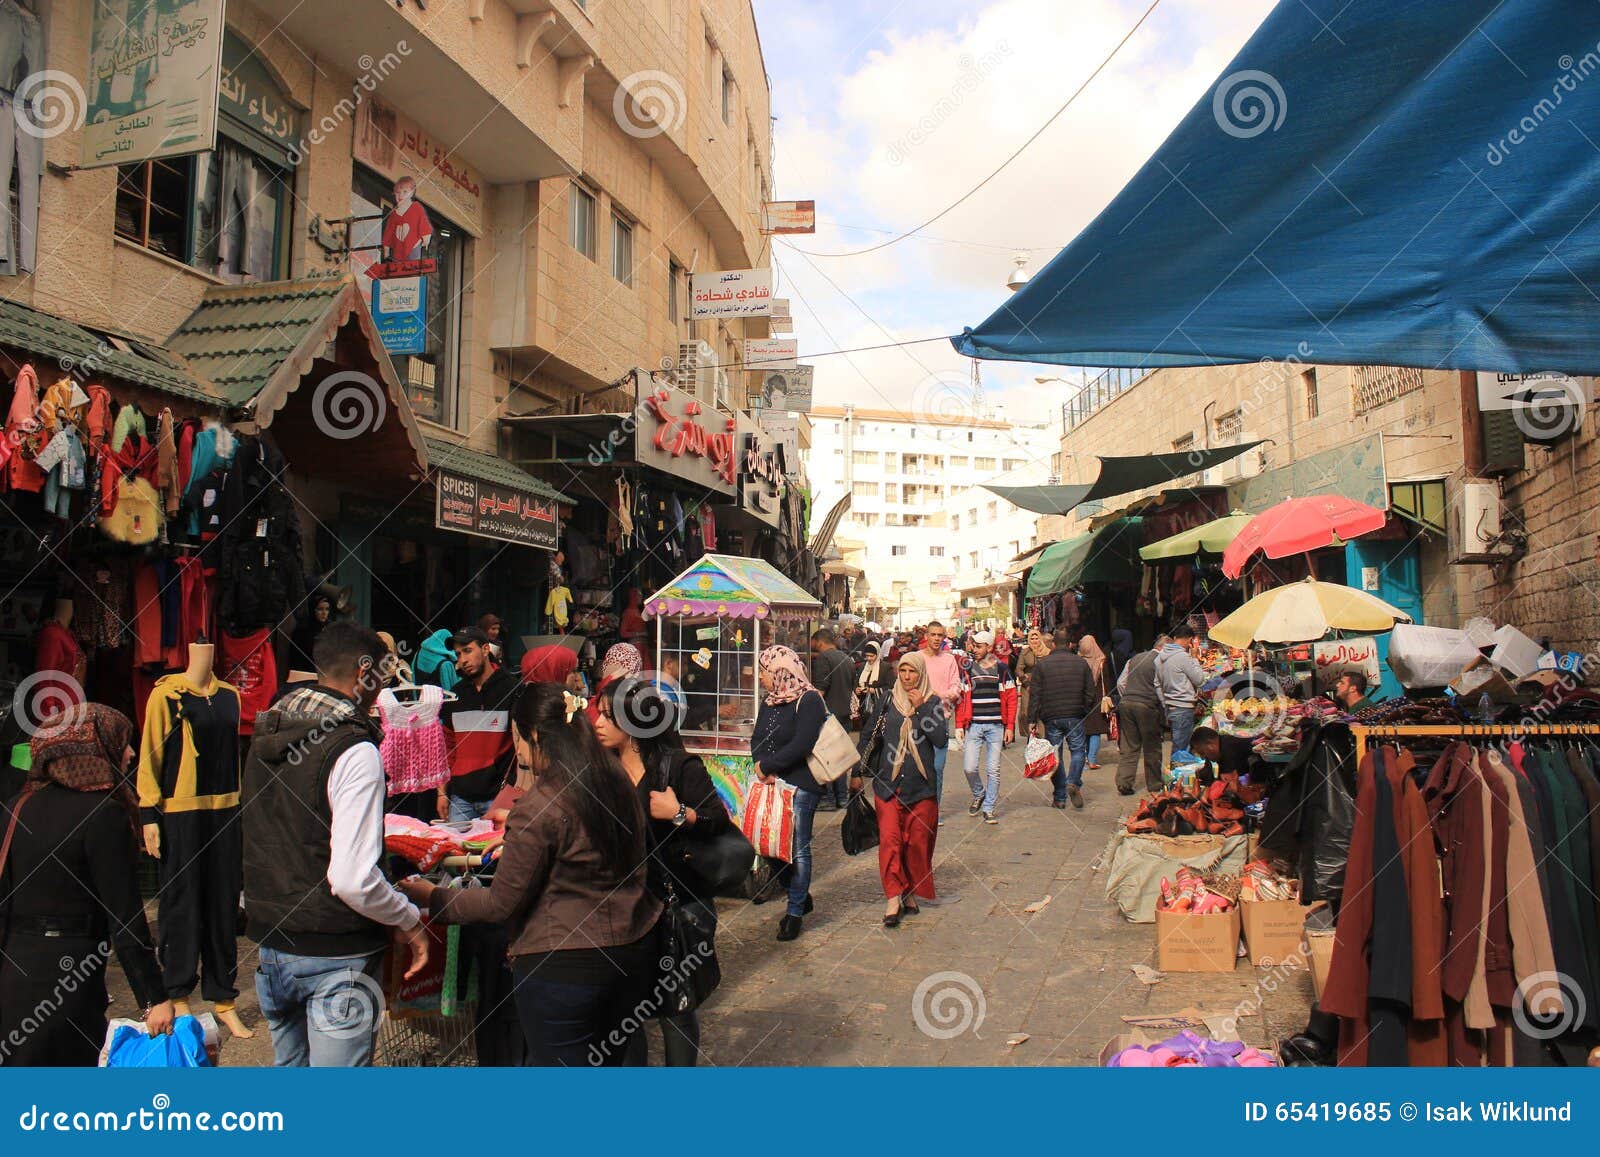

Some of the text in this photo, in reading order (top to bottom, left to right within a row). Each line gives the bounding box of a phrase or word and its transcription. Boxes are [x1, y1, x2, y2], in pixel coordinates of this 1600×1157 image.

[719, 273, 744, 283] الدكتور
[695, 286, 770, 302] شادي شحادة
[443, 476, 475, 498] SPICES
